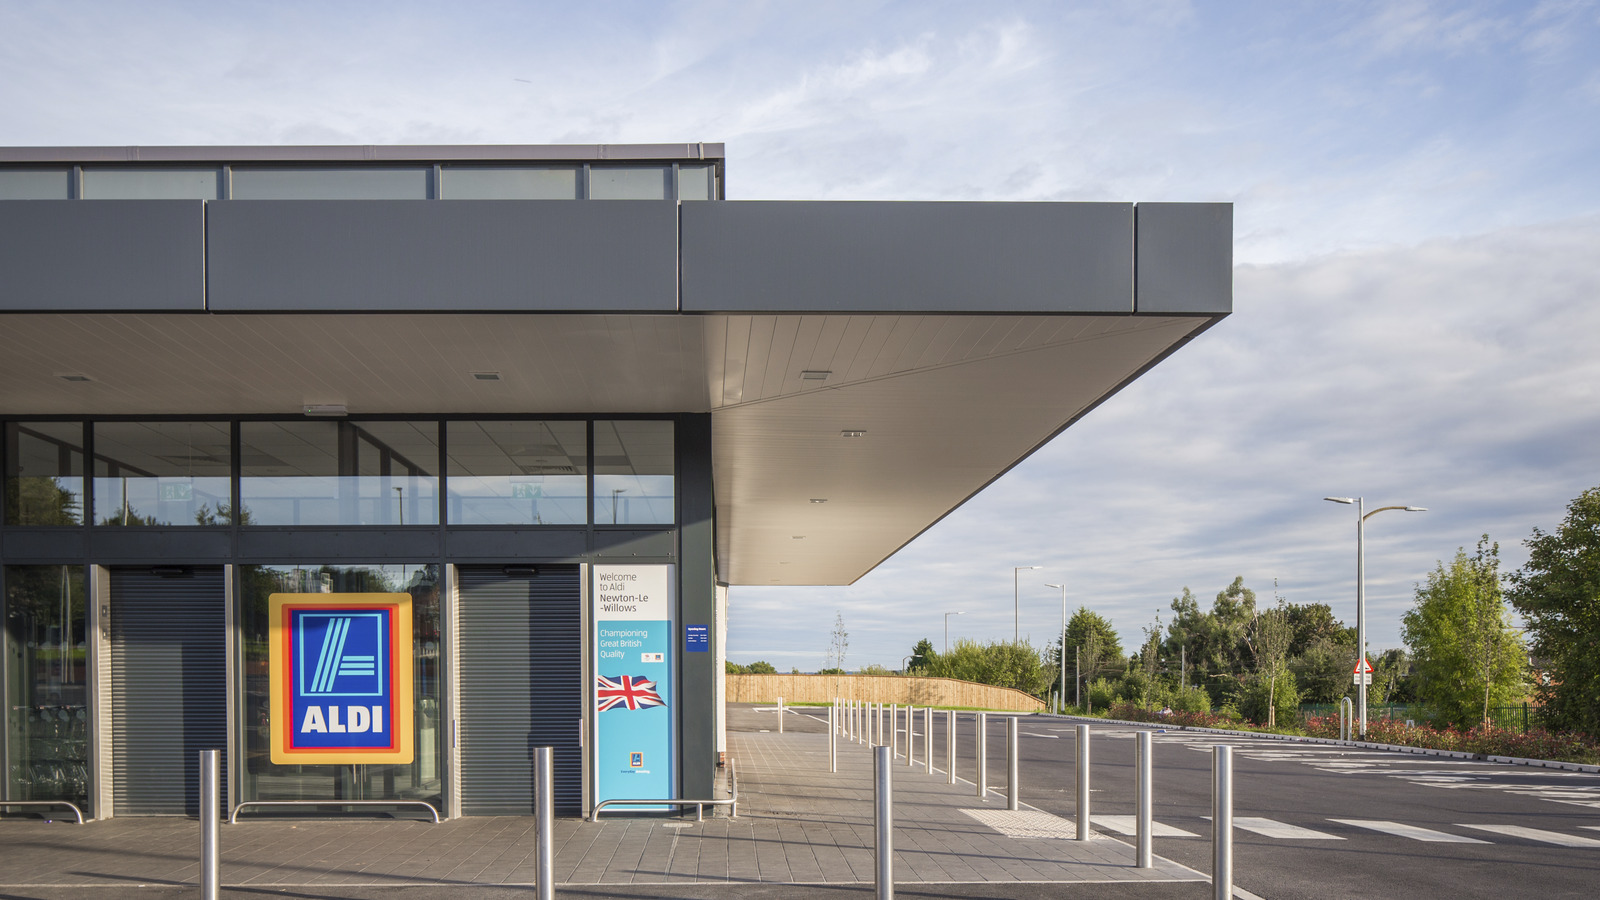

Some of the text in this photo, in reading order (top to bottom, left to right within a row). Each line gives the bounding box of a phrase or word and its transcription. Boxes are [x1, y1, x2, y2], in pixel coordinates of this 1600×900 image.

[600, 572, 637, 581] Welcome
[600, 582, 625, 591] to Aldi
[600, 594, 648, 602] Newton-Le
[600, 604, 636, 612] -Willows
[600, 629, 648, 638] Championing
[600, 640, 642, 648] Great British
[600, 650, 625, 660] Quality
[300, 706, 382, 733] ALDI
